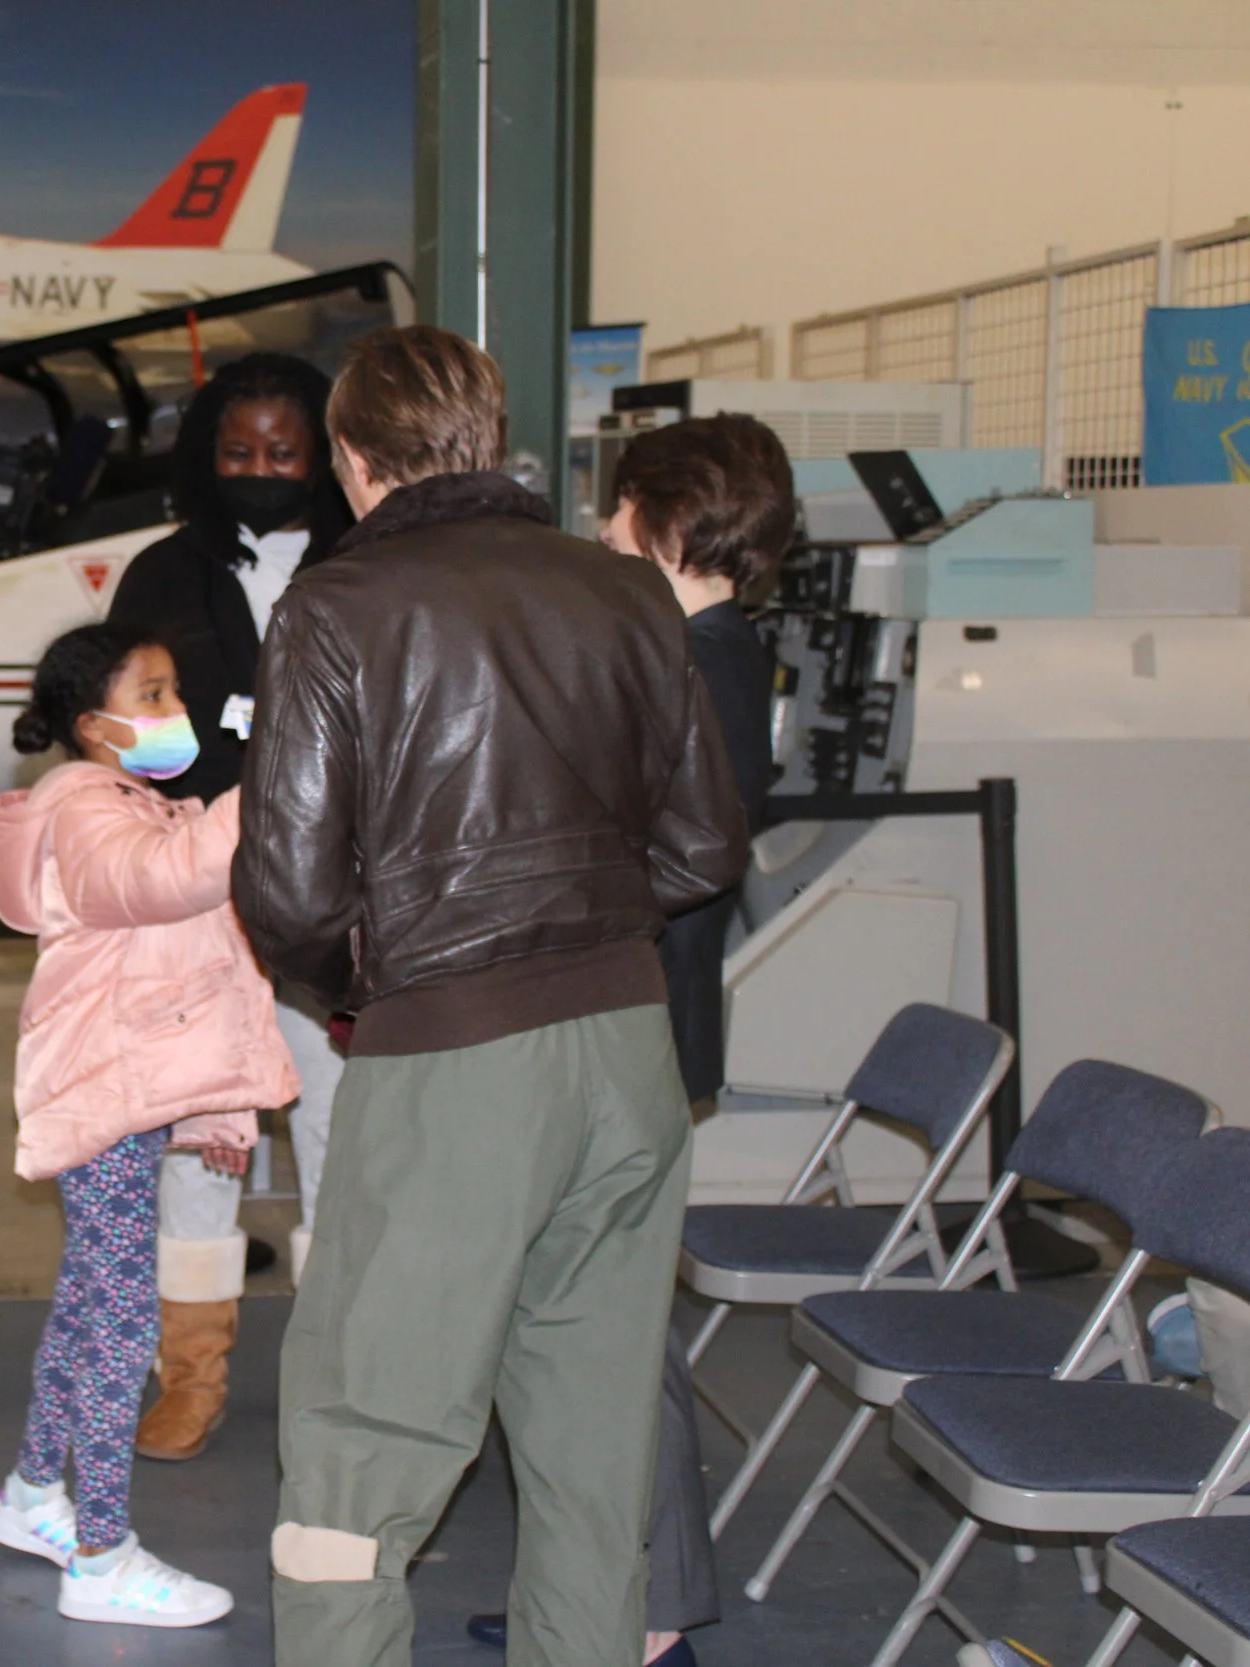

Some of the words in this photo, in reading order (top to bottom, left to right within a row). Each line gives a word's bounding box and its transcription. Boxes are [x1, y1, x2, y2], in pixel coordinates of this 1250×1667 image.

[172, 160, 236, 219] B
[10, 274, 116, 311] NAVY
[1173, 375, 1228, 402] NAVY
